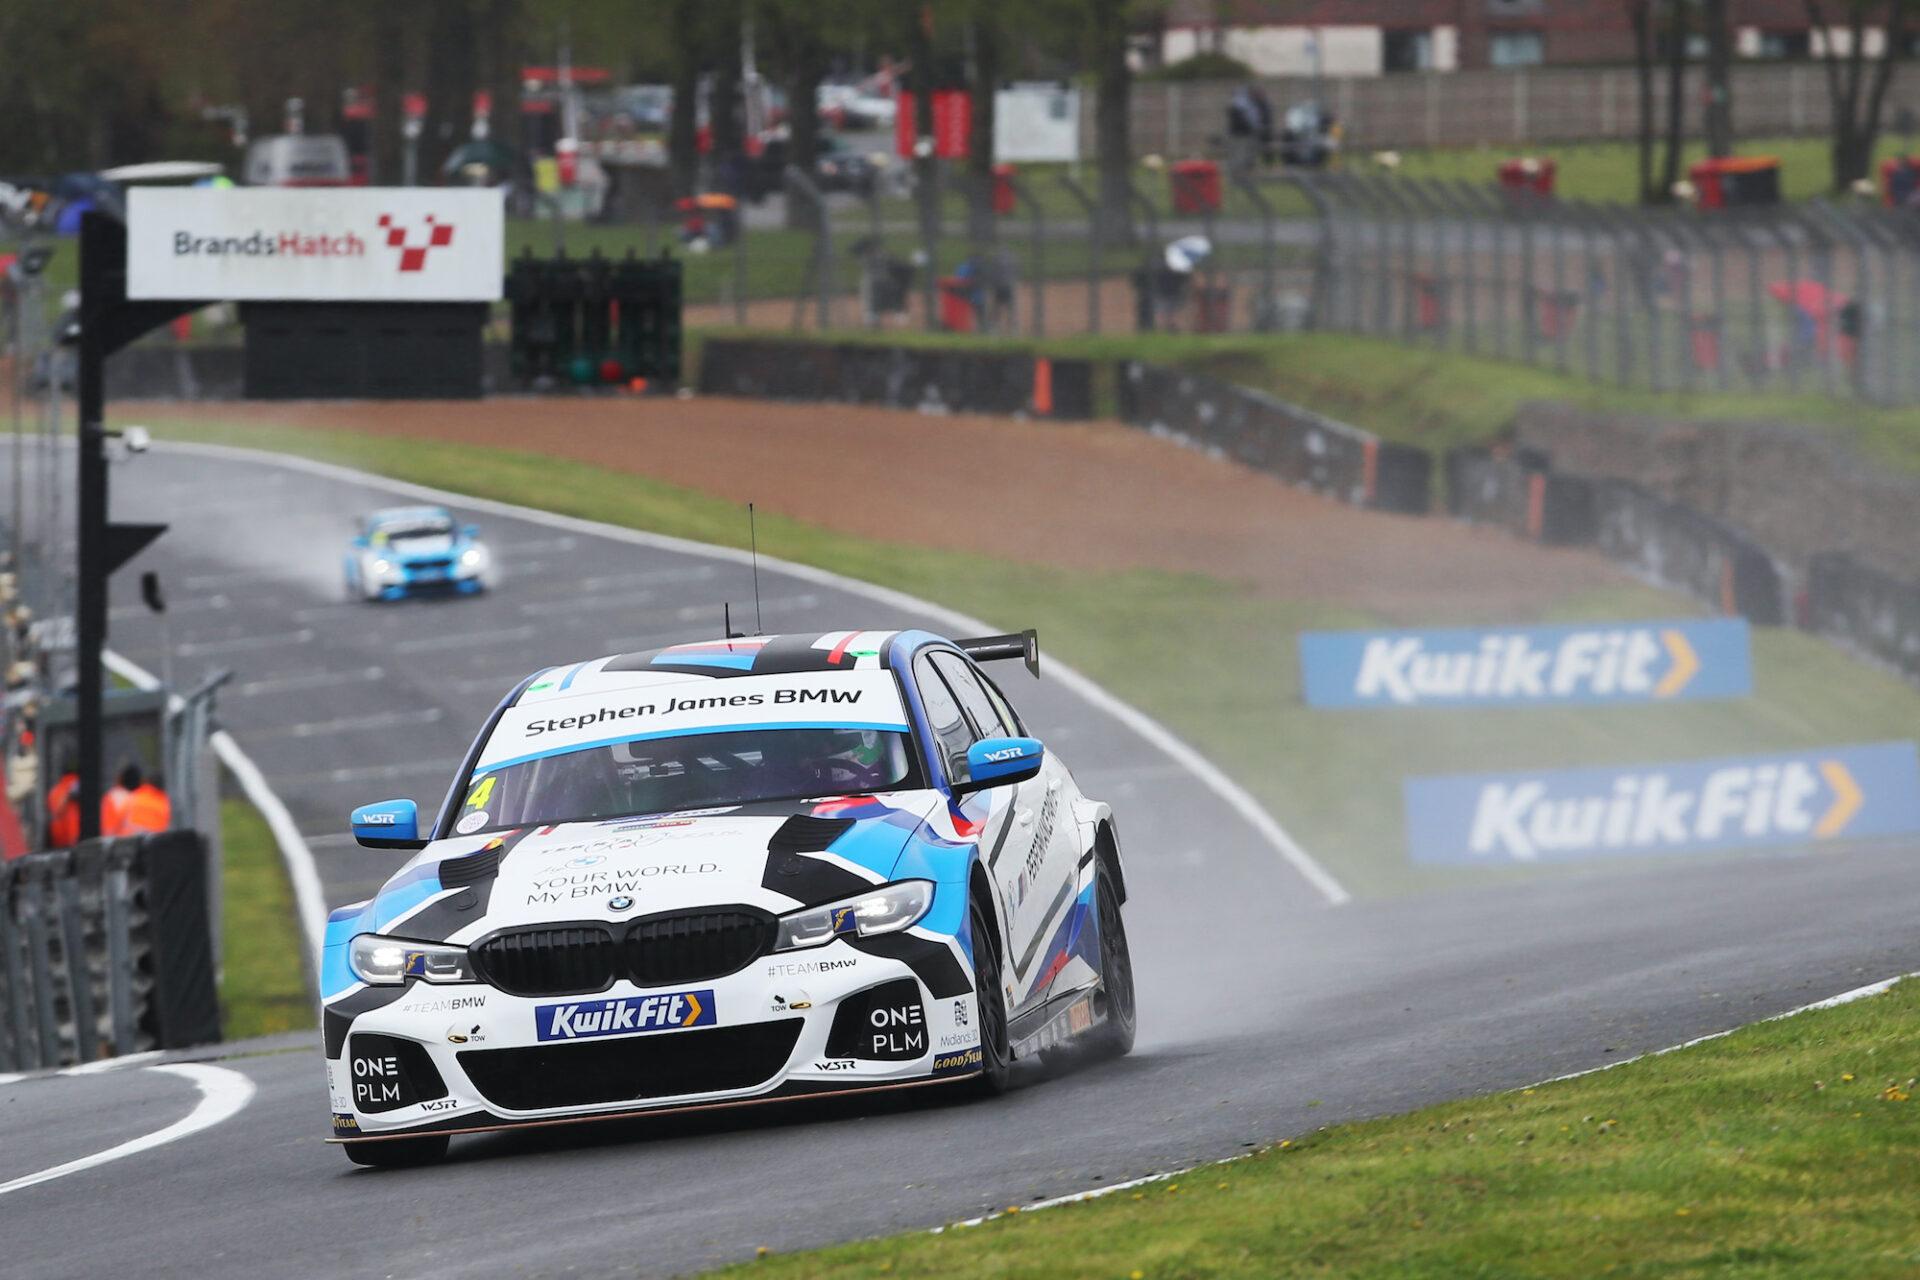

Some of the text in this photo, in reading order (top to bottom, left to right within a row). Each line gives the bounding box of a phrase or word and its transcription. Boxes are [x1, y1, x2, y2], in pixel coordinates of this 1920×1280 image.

[525, 688, 863, 737] Stephen James BMW
[466, 776, 497, 810] 4
[533, 862, 723, 890] YOUR WORLD.
[571, 880, 643, 899] BMW.
[768, 959, 858, 978] #TEAMBMW
[771, 1004, 787, 1012] TOW
[871, 1004, 922, 1028] ONE
[873, 1031, 923, 1054] PLM
[353, 1056, 399, 1077] ONE
[814, 1060, 857, 1071] WSR
[356, 1082, 401, 1102] PLM
[420, 1099, 458, 1111] WSR
